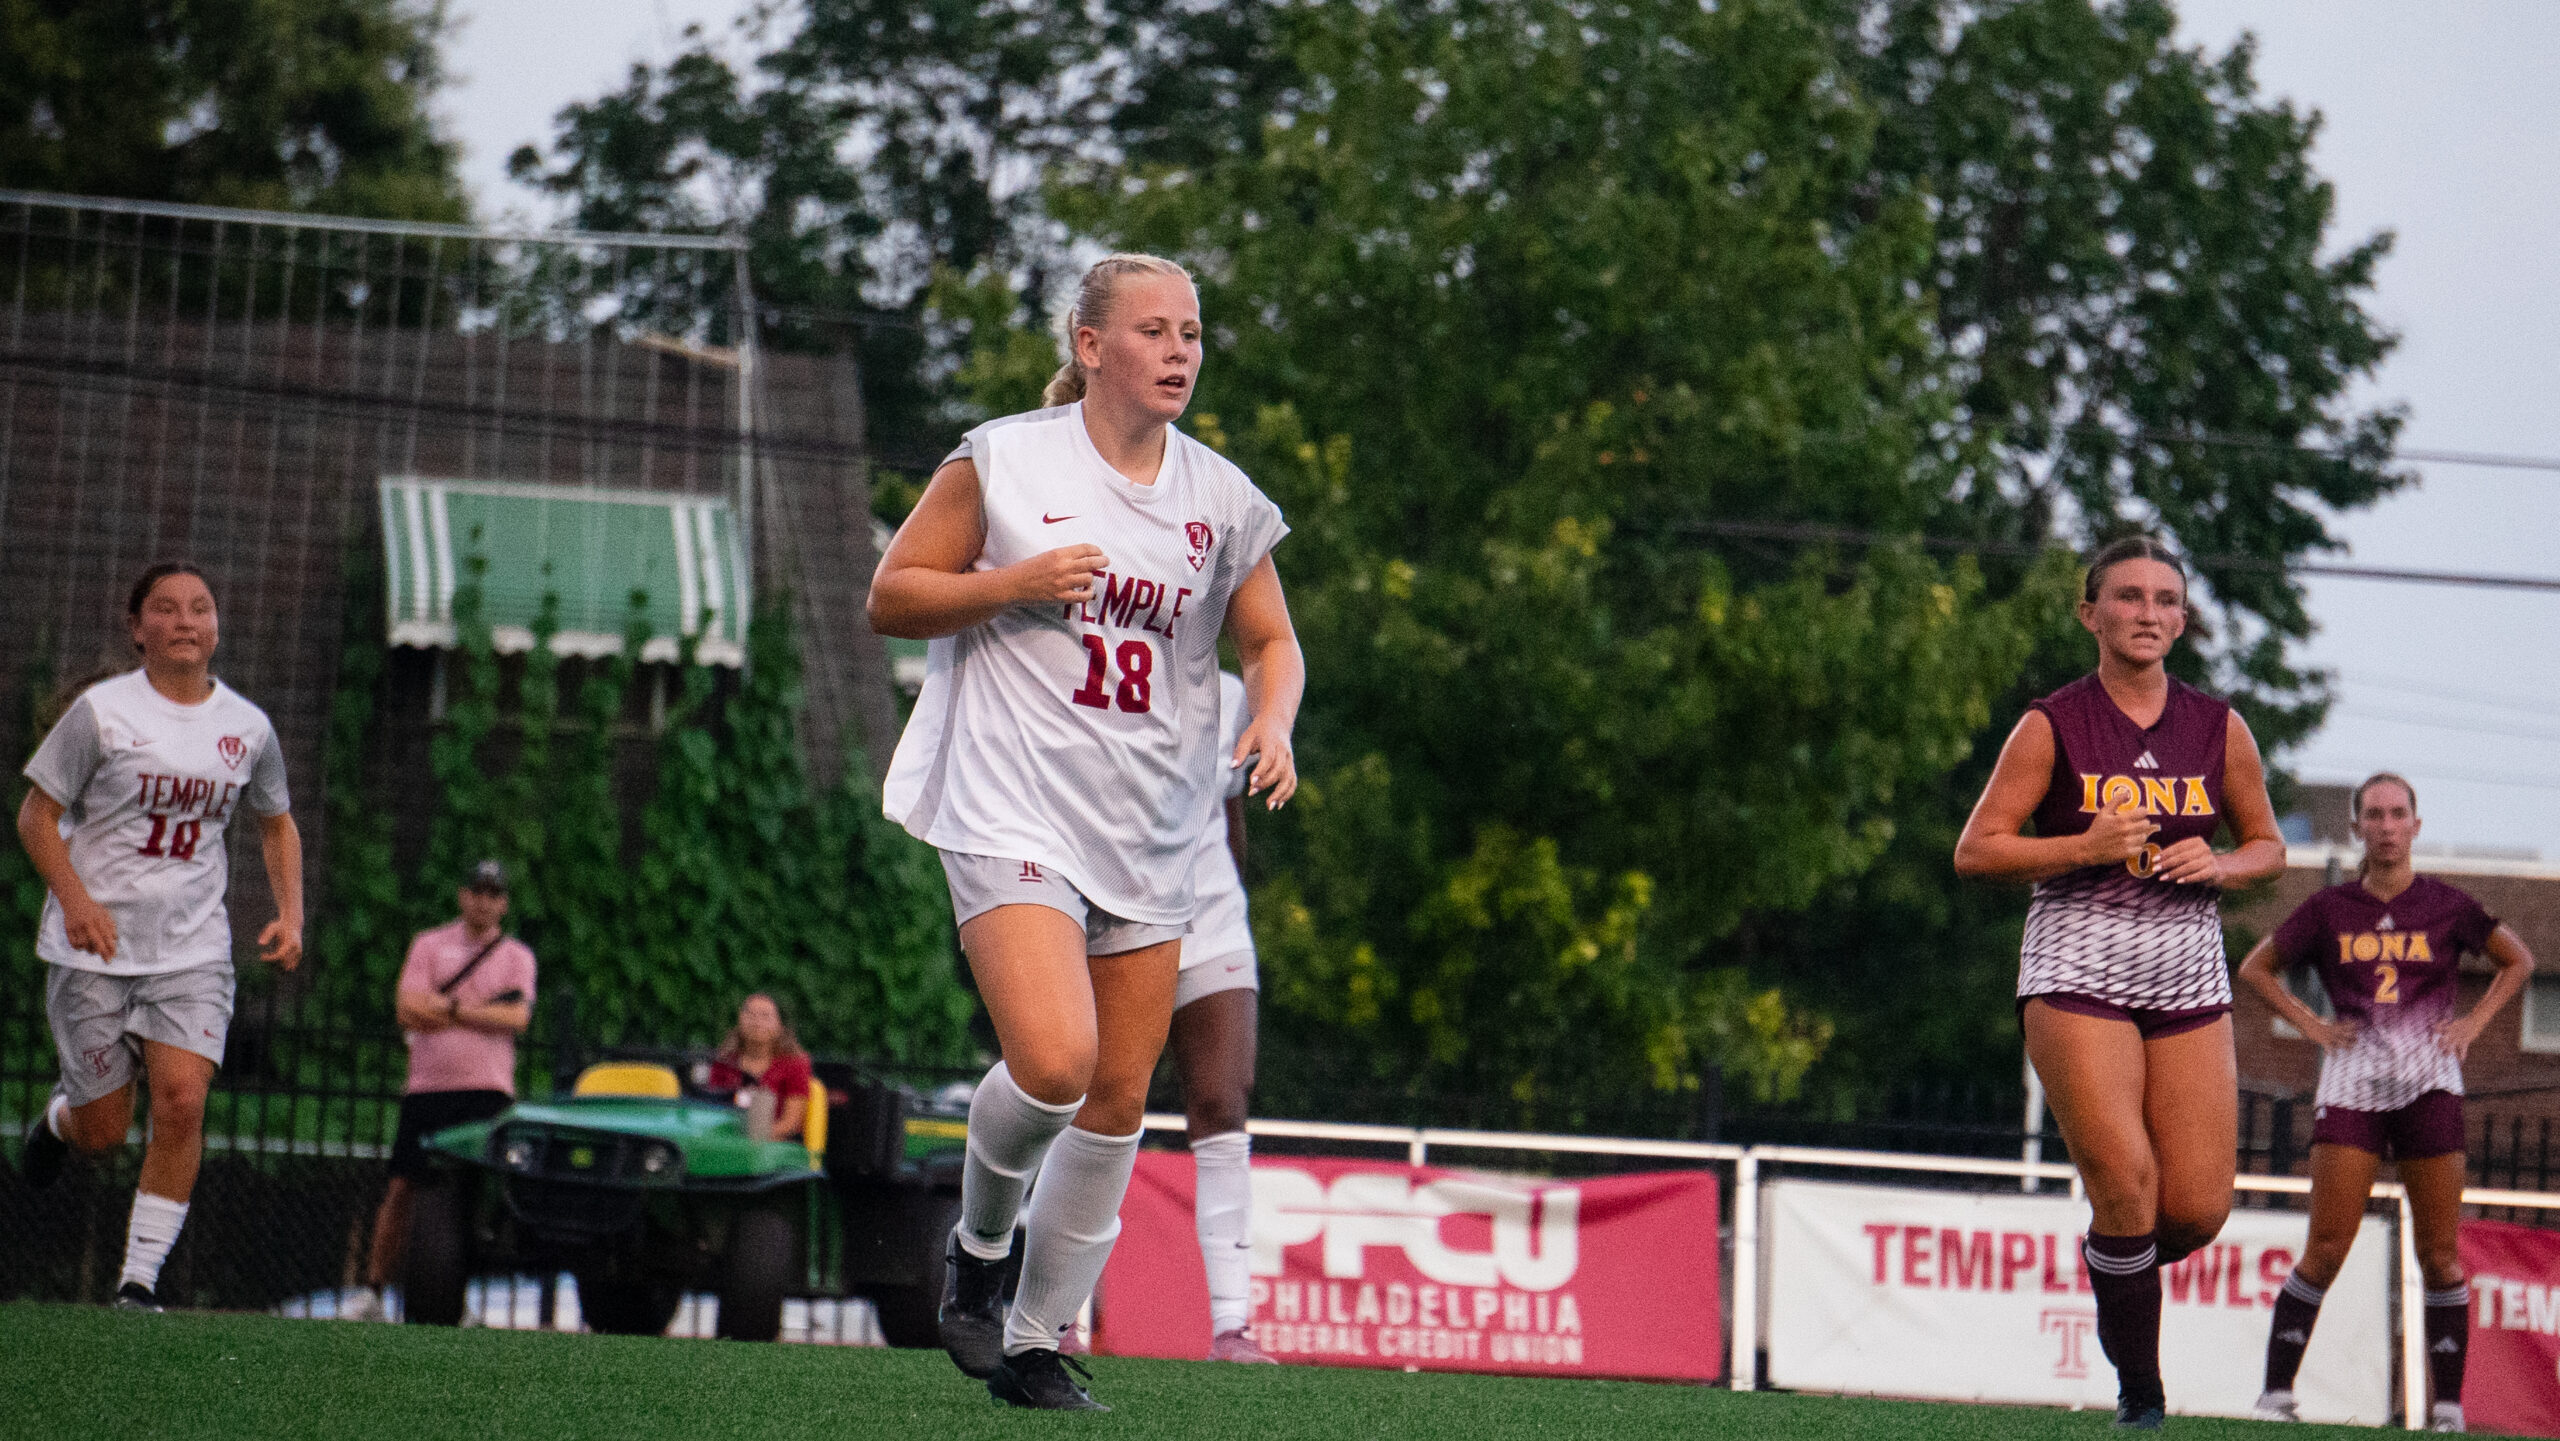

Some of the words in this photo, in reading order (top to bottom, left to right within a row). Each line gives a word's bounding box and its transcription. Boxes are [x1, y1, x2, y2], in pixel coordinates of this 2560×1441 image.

[1063, 569, 1193, 640] MPLE
[1072, 633, 1153, 714] 18
[138, 773, 238, 818] TEMPLE
[2079, 773, 2216, 817] IONA
[138, 813, 202, 861] 10
[2338, 931, 2434, 964] IONA
[2374, 964, 2399, 1004] 2
[1250, 1168, 1580, 1292] PFCU
[2169, 1244, 2294, 1310] WLS
[1249, 1279, 1583, 1336] PHILADELPHIA
[1377, 1327, 1482, 1361] CREDIT
